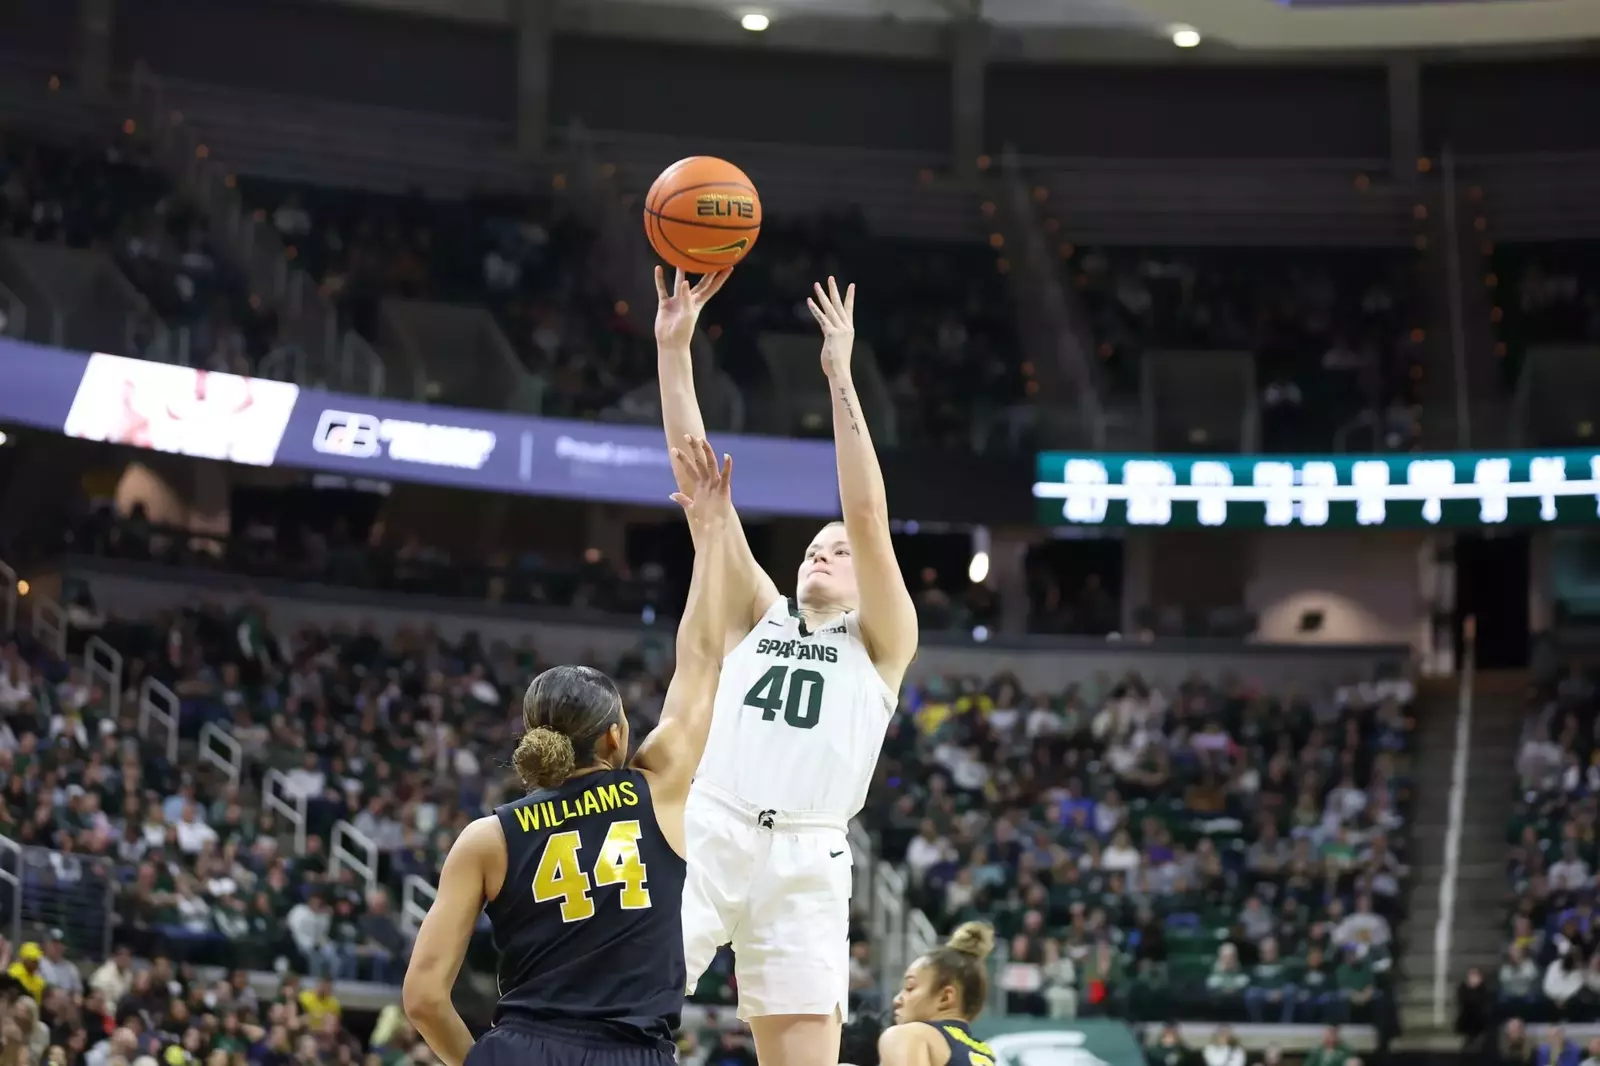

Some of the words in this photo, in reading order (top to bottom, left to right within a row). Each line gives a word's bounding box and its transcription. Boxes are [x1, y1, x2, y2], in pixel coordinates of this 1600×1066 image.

[743, 665, 825, 729] 40
[514, 781, 639, 832] WILLIAMS
[532, 819, 652, 923] 44
